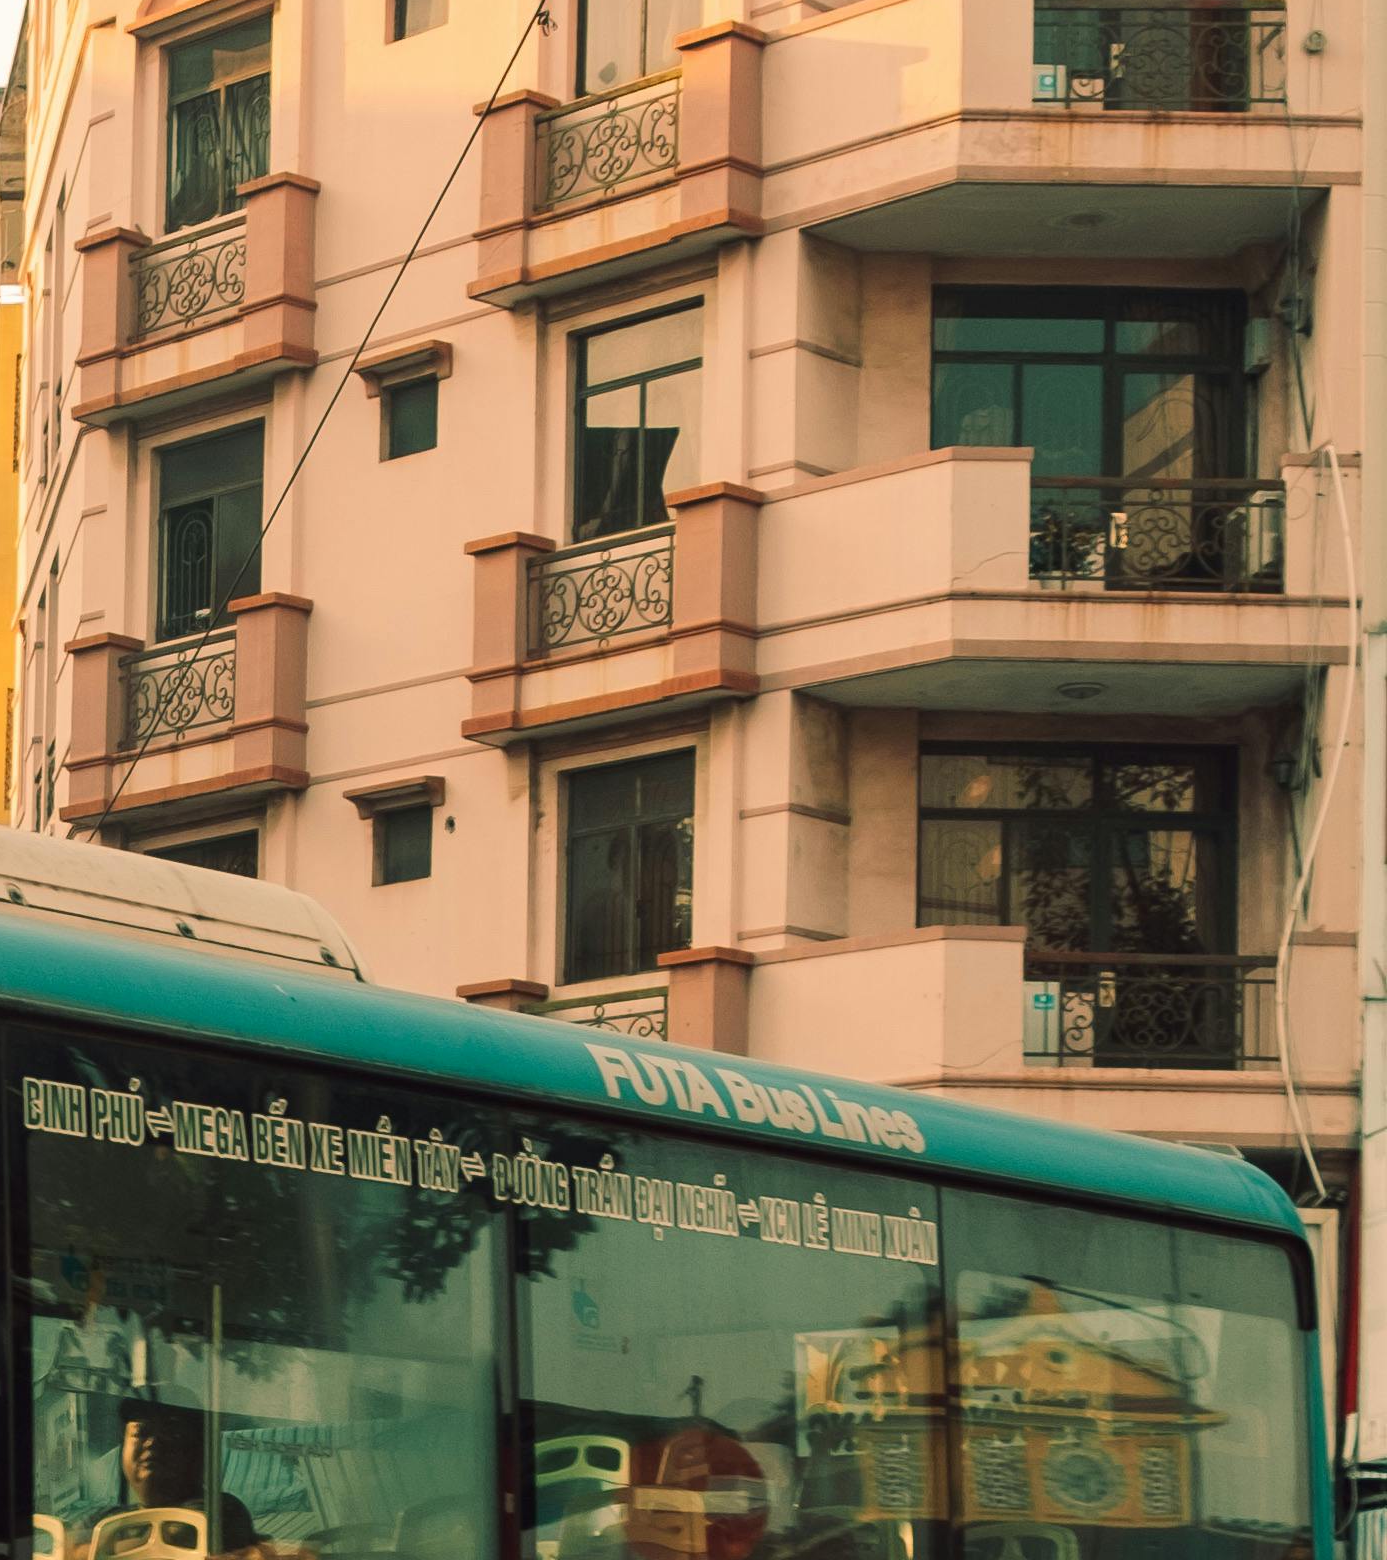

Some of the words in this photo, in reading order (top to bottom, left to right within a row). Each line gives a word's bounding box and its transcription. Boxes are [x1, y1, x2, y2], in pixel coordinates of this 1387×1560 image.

[584, 1042, 731, 1119] FUTA
[90, 1077, 145, 1146] PHÚ
[172, 1101, 250, 1161] MEGA
[251, 1097, 306, 1170] BẾN
[308, 1122, 346, 1175] XE
[414, 1127, 461, 1193] TÂY
[634, 1175, 675, 1241] ĐẠI
[759, 1195, 802, 1247] KCN
[802, 1192, 830, 1251] LÊ
[830, 1206, 883, 1258] MINH
[882, 1206, 939, 1266] XUÂN
